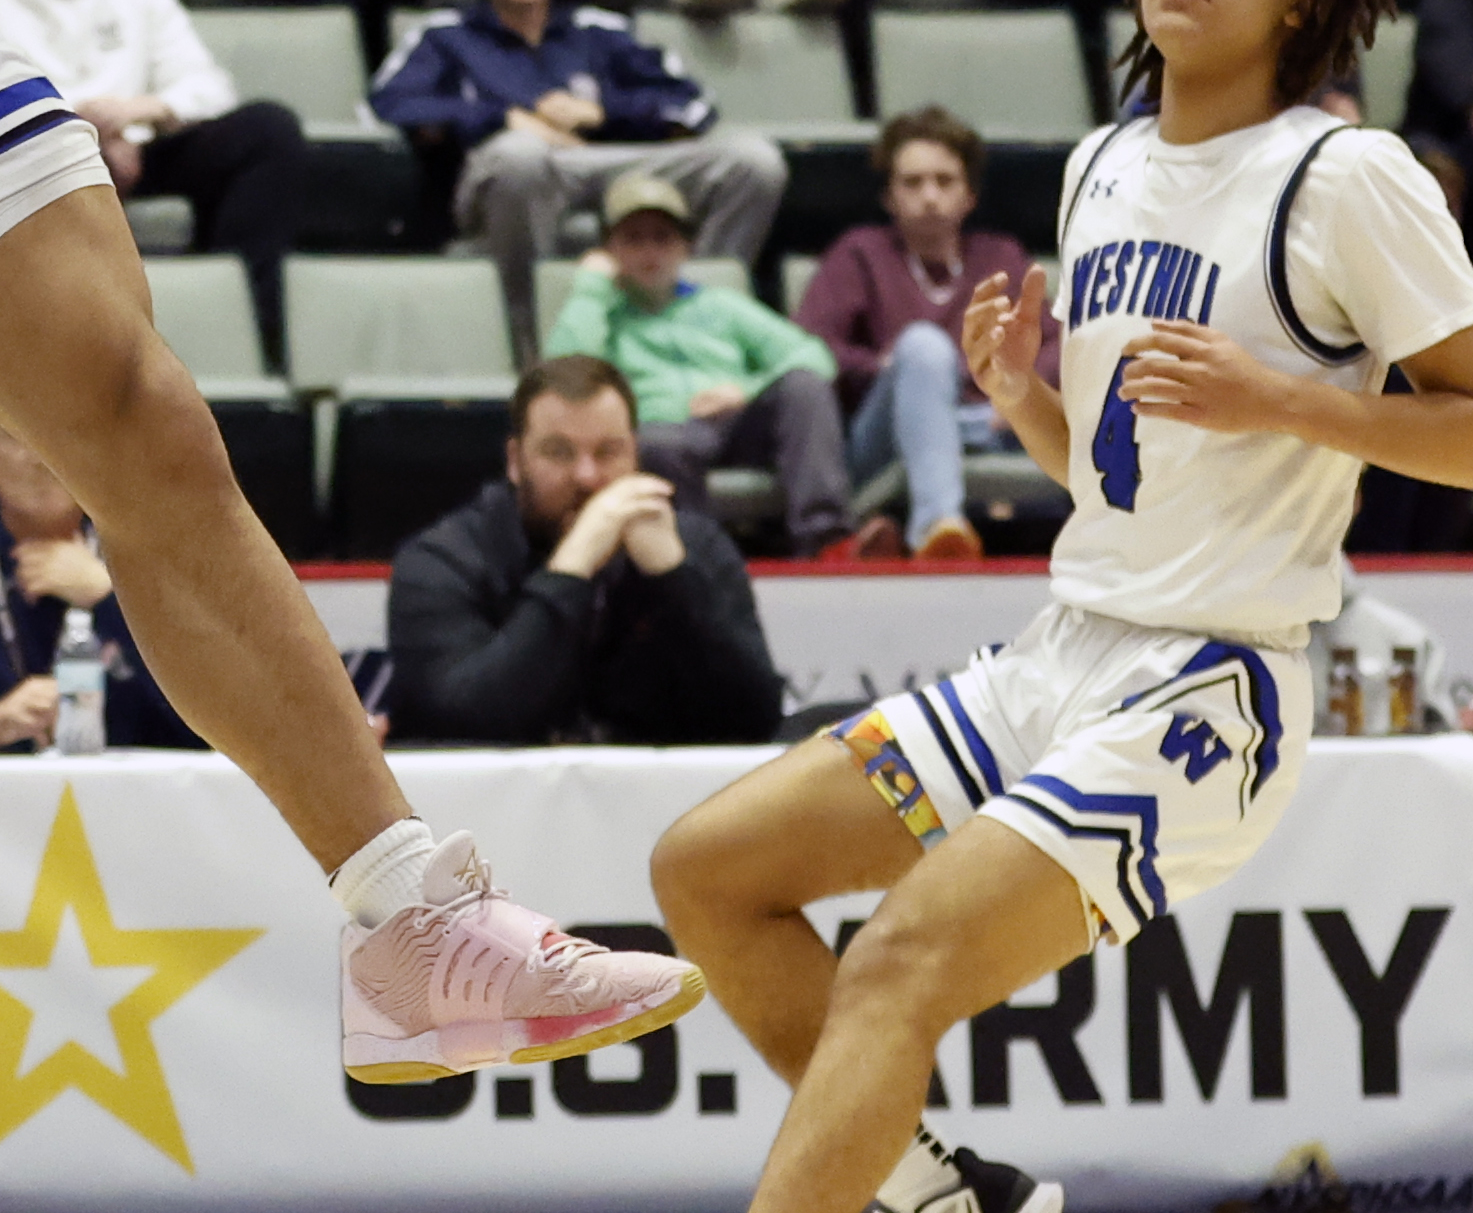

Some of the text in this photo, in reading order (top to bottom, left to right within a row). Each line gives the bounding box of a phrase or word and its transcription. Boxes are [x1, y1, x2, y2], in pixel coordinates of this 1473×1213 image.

[1069, 240, 1221, 332] WESTHILL
[1092, 355, 1142, 514] 4
[832, 904, 1455, 1112] RMY
